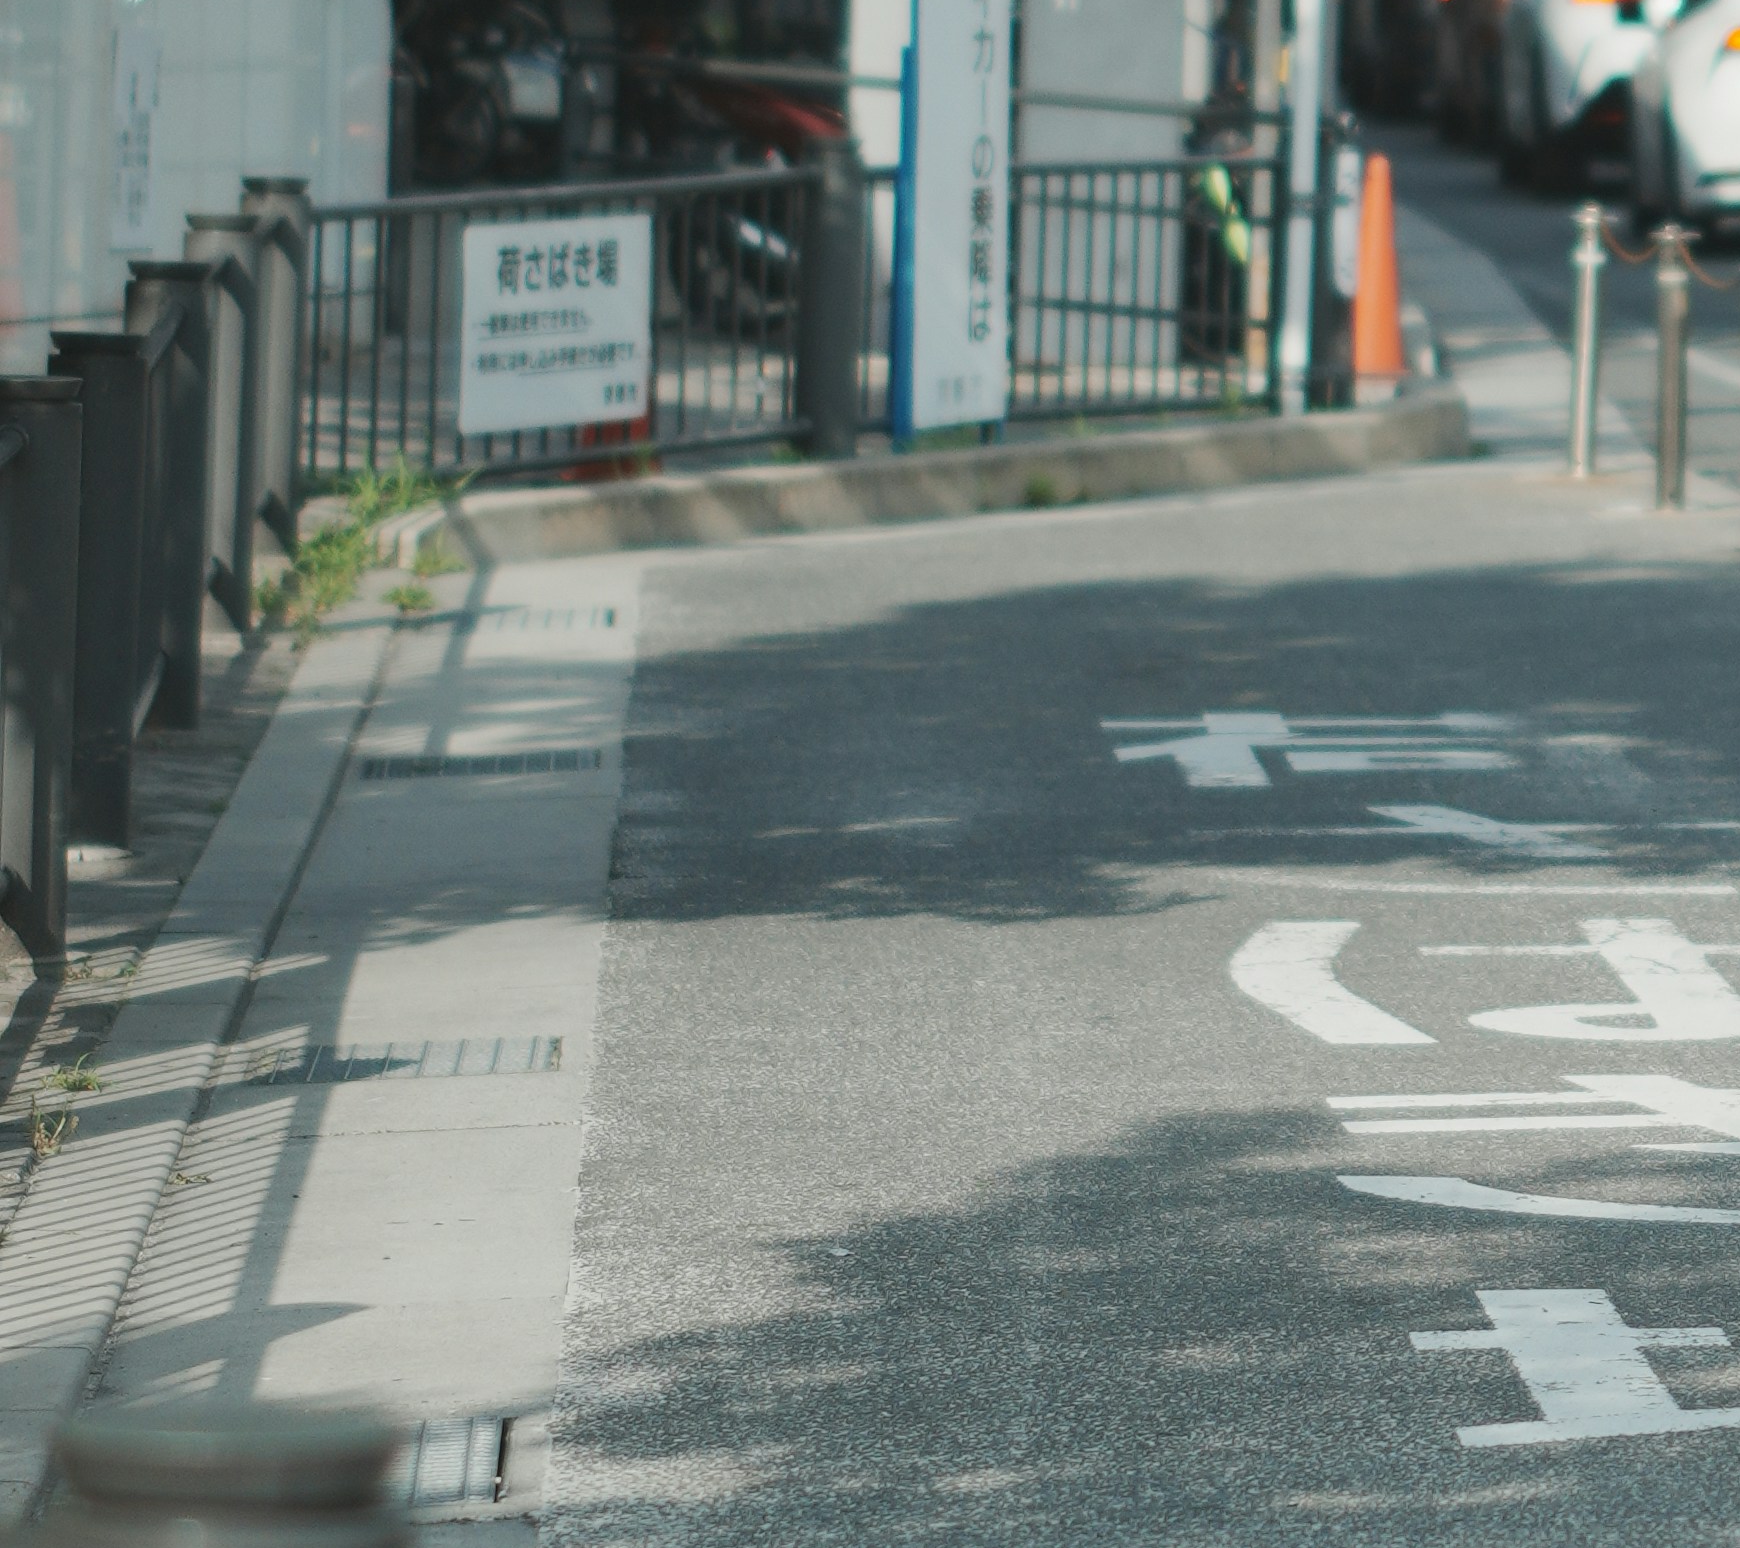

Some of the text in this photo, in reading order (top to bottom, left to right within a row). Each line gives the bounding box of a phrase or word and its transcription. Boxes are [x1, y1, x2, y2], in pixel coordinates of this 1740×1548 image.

[497, 238, 620, 296] 荷さばき場
